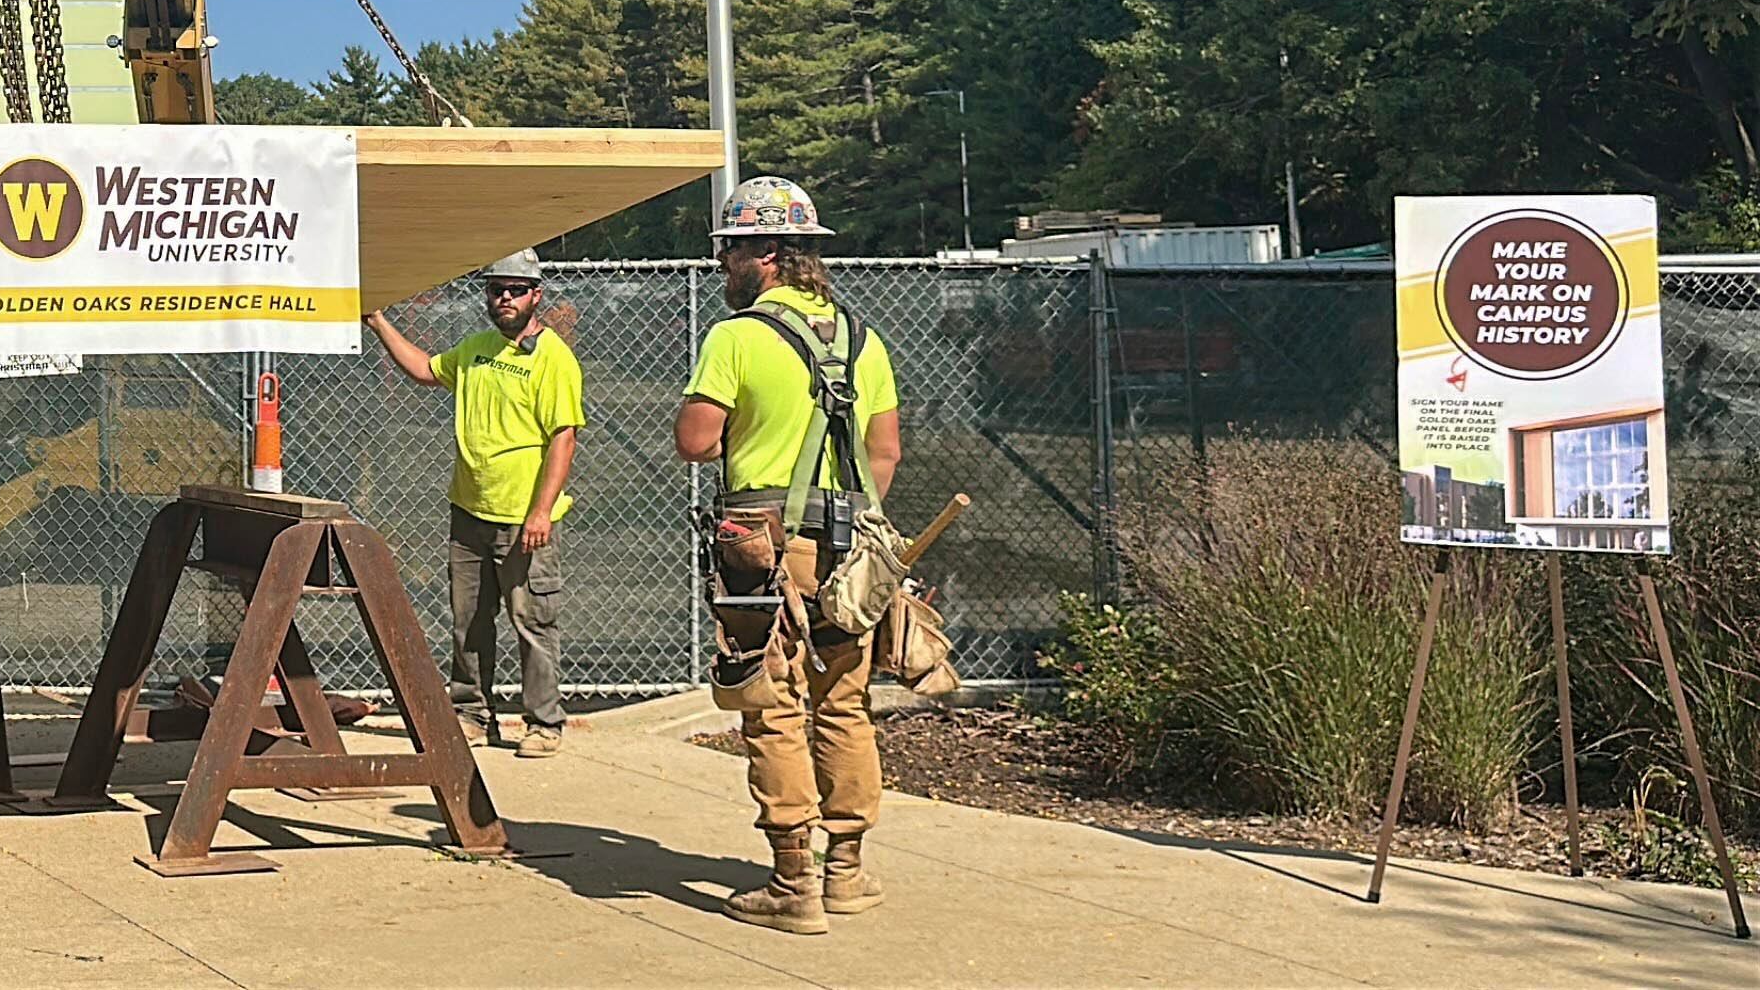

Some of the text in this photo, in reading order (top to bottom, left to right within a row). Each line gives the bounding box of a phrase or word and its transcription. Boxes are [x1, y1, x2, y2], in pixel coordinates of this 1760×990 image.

[96, 166, 275, 207] WESTERN
[2, 182, 68, 242] W
[98, 210, 299, 251] MICHIGAN
[1492, 241, 1568, 259] MAKE
[1495, 262, 1567, 280] YOUR
[1470, 284, 1593, 302] MARK ON
[73, 296, 132, 312] OAKS
[140, 295, 263, 312] RESIDENCE
[270, 297, 317, 312] HALL
[1477, 304, 1587, 323] CAMPUS
[1476, 326, 1590, 345] HISTORY
[1411, 398, 1437, 406] SIGN
[1440, 399, 1470, 407] YOUR
[1416, 425, 1497, 434] PANEL BEFORE
[1419, 416, 1497, 425] GOLDEN OAKS
[1449, 434, 1491, 442] RAISED
